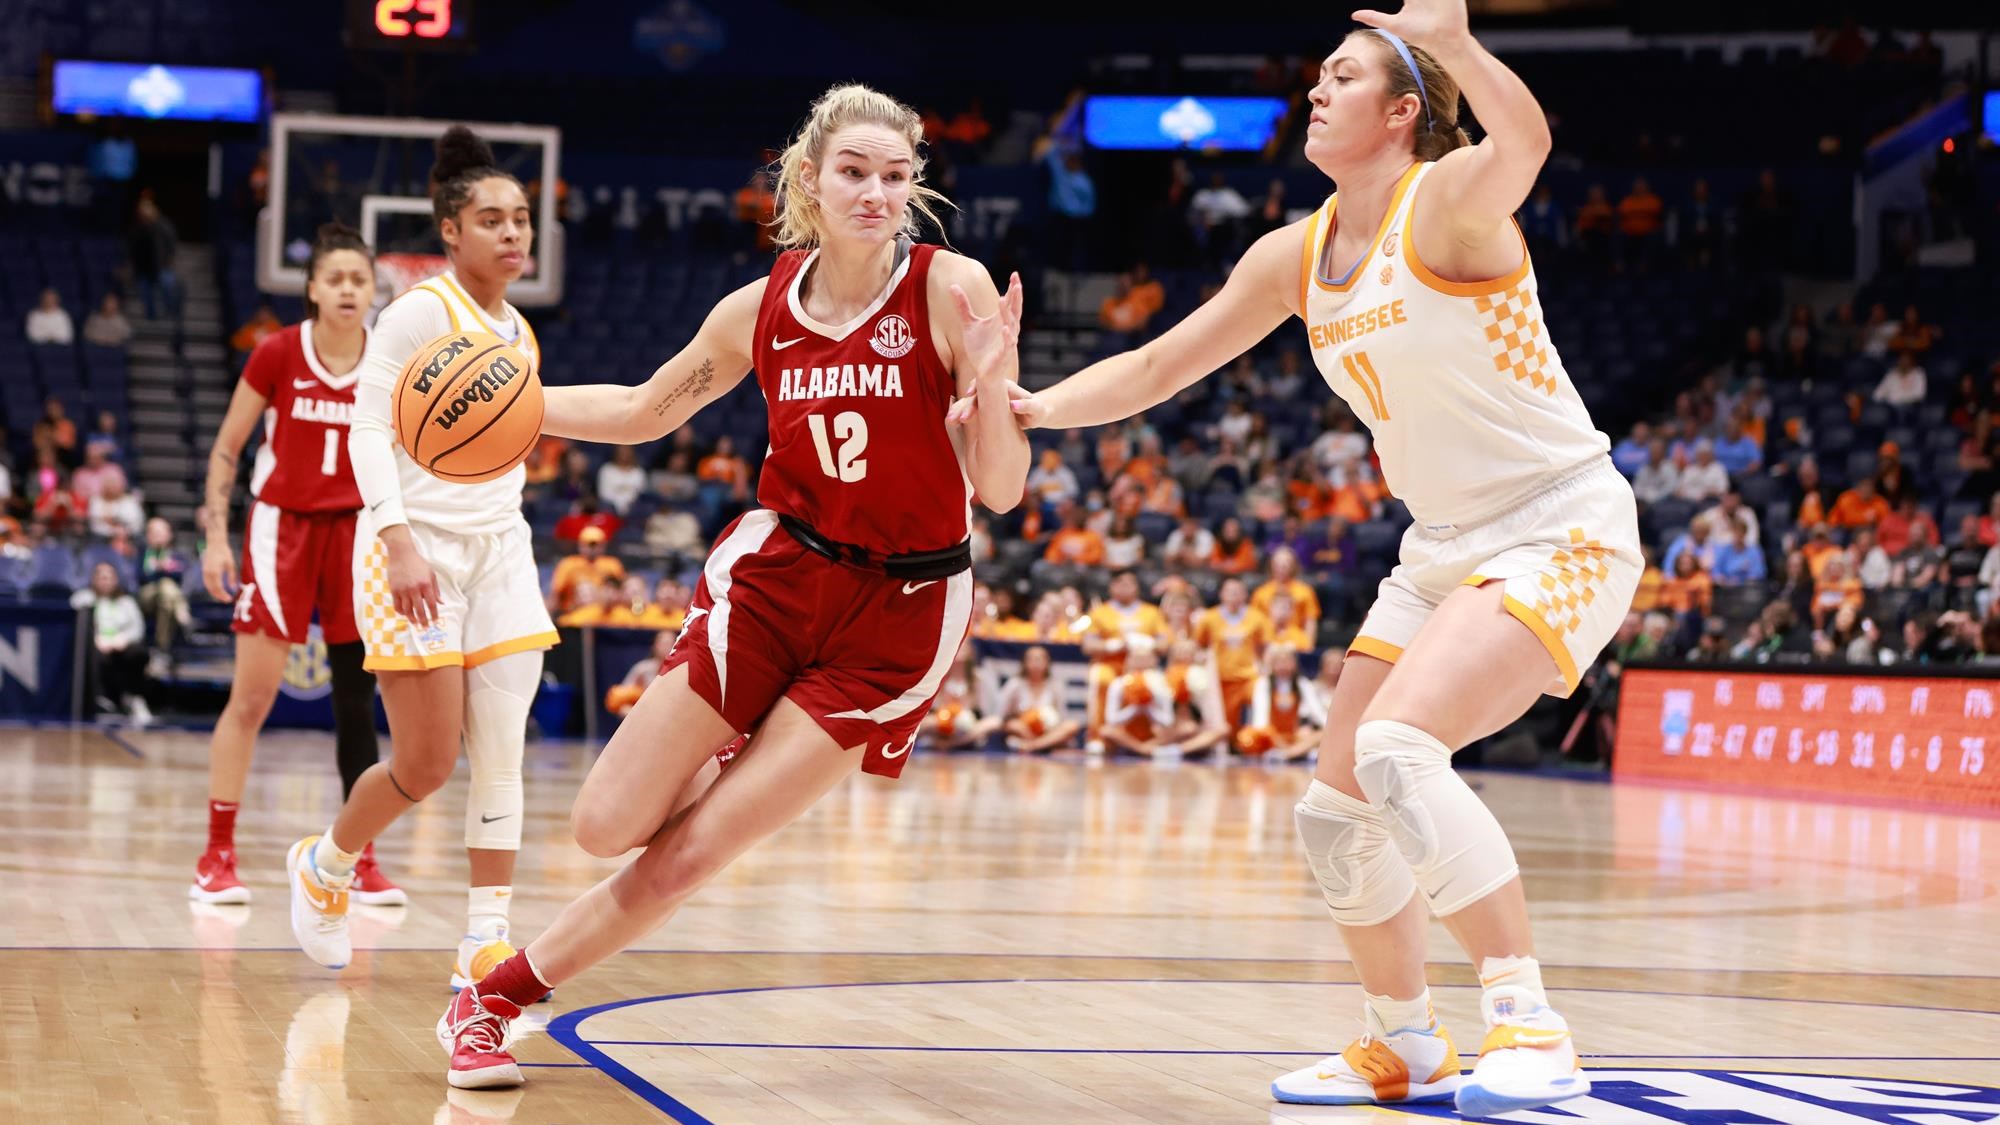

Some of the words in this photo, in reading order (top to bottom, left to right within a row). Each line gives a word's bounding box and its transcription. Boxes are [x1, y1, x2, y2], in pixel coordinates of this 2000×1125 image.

[376, 0, 451, 37] 23
[878, 317, 907, 348] SEC
[412, 336, 474, 395] NCAA
[778, 363, 904, 402] ALABAMA
[1342, 351, 1391, 421] 11
[434, 356, 520, 430] Wilson
[322, 428, 340, 476] 1
[807, 411, 869, 483] 12
[1958, 736, 1986, 776] 75
